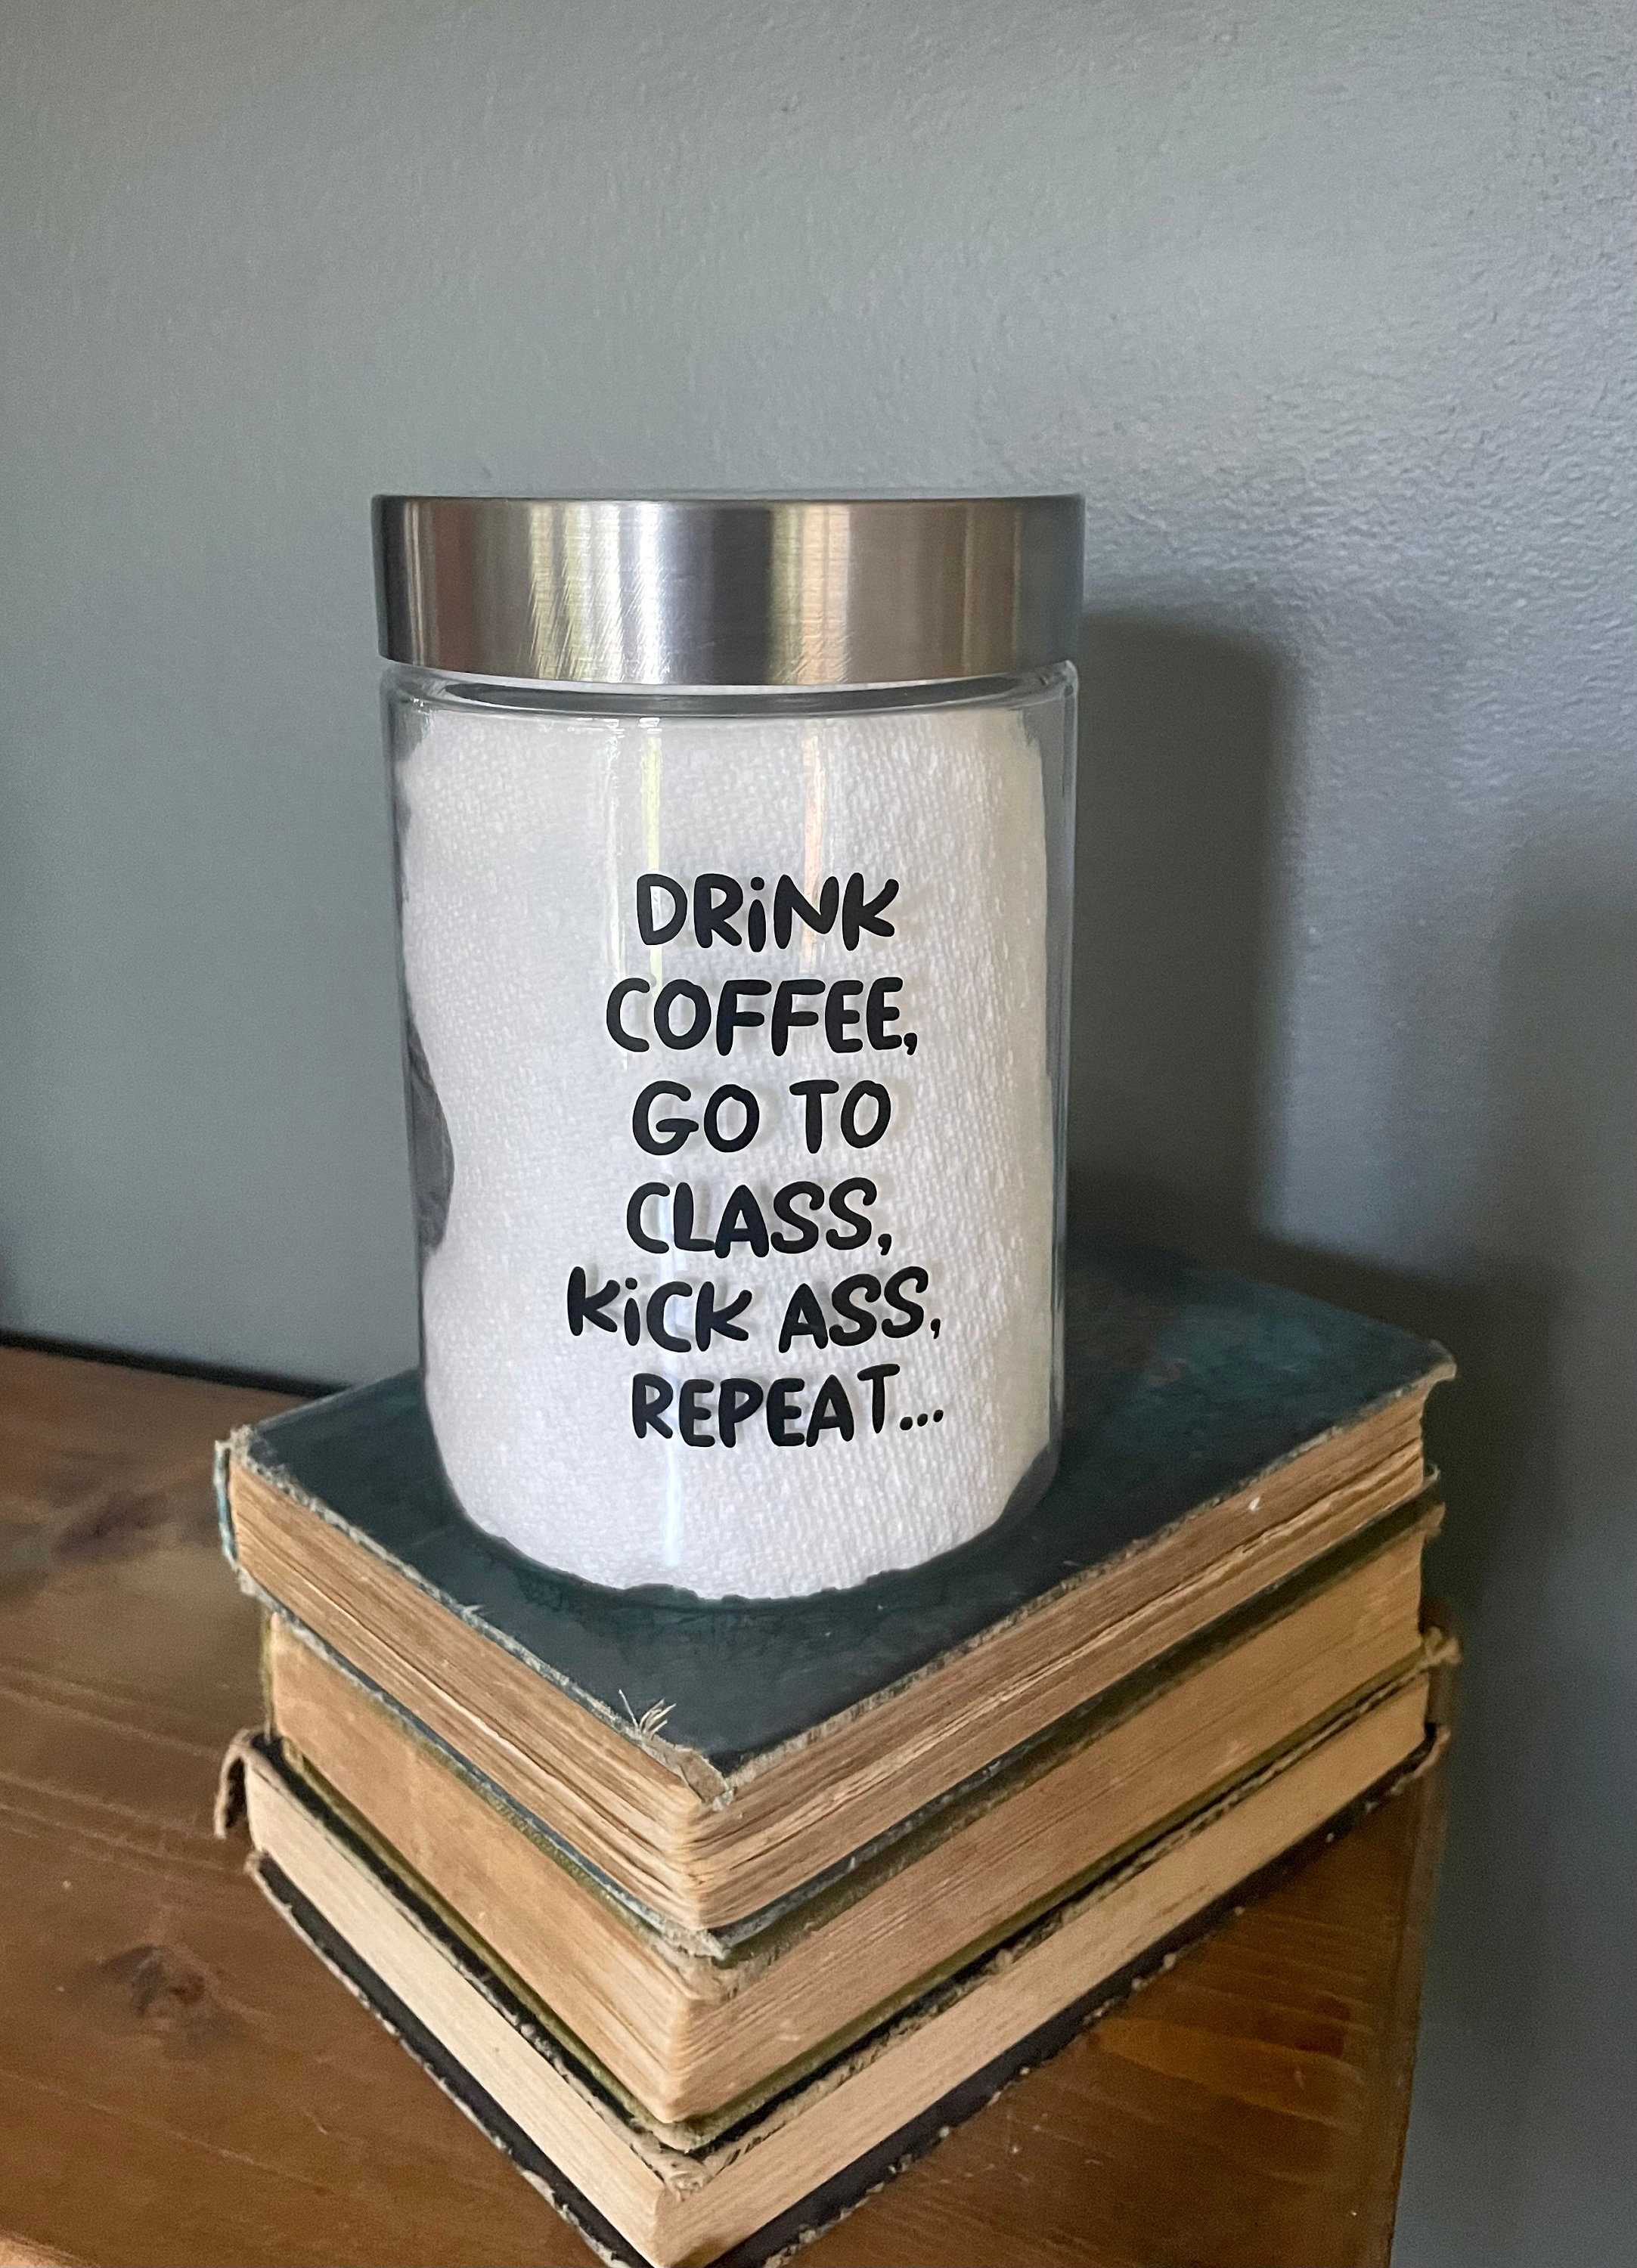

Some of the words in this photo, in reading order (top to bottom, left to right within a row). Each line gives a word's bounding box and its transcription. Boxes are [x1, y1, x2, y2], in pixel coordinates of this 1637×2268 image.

[606, 977, 918, 1057] COFFEE,
[632, 1080, 760, 1154] GO
[789, 1079, 891, 1154] TO
[626, 1177, 892, 1259] CLASS,
[778, 1266, 941, 1354] ASS,
[631, 1363, 944, 1448] REPEAT...
